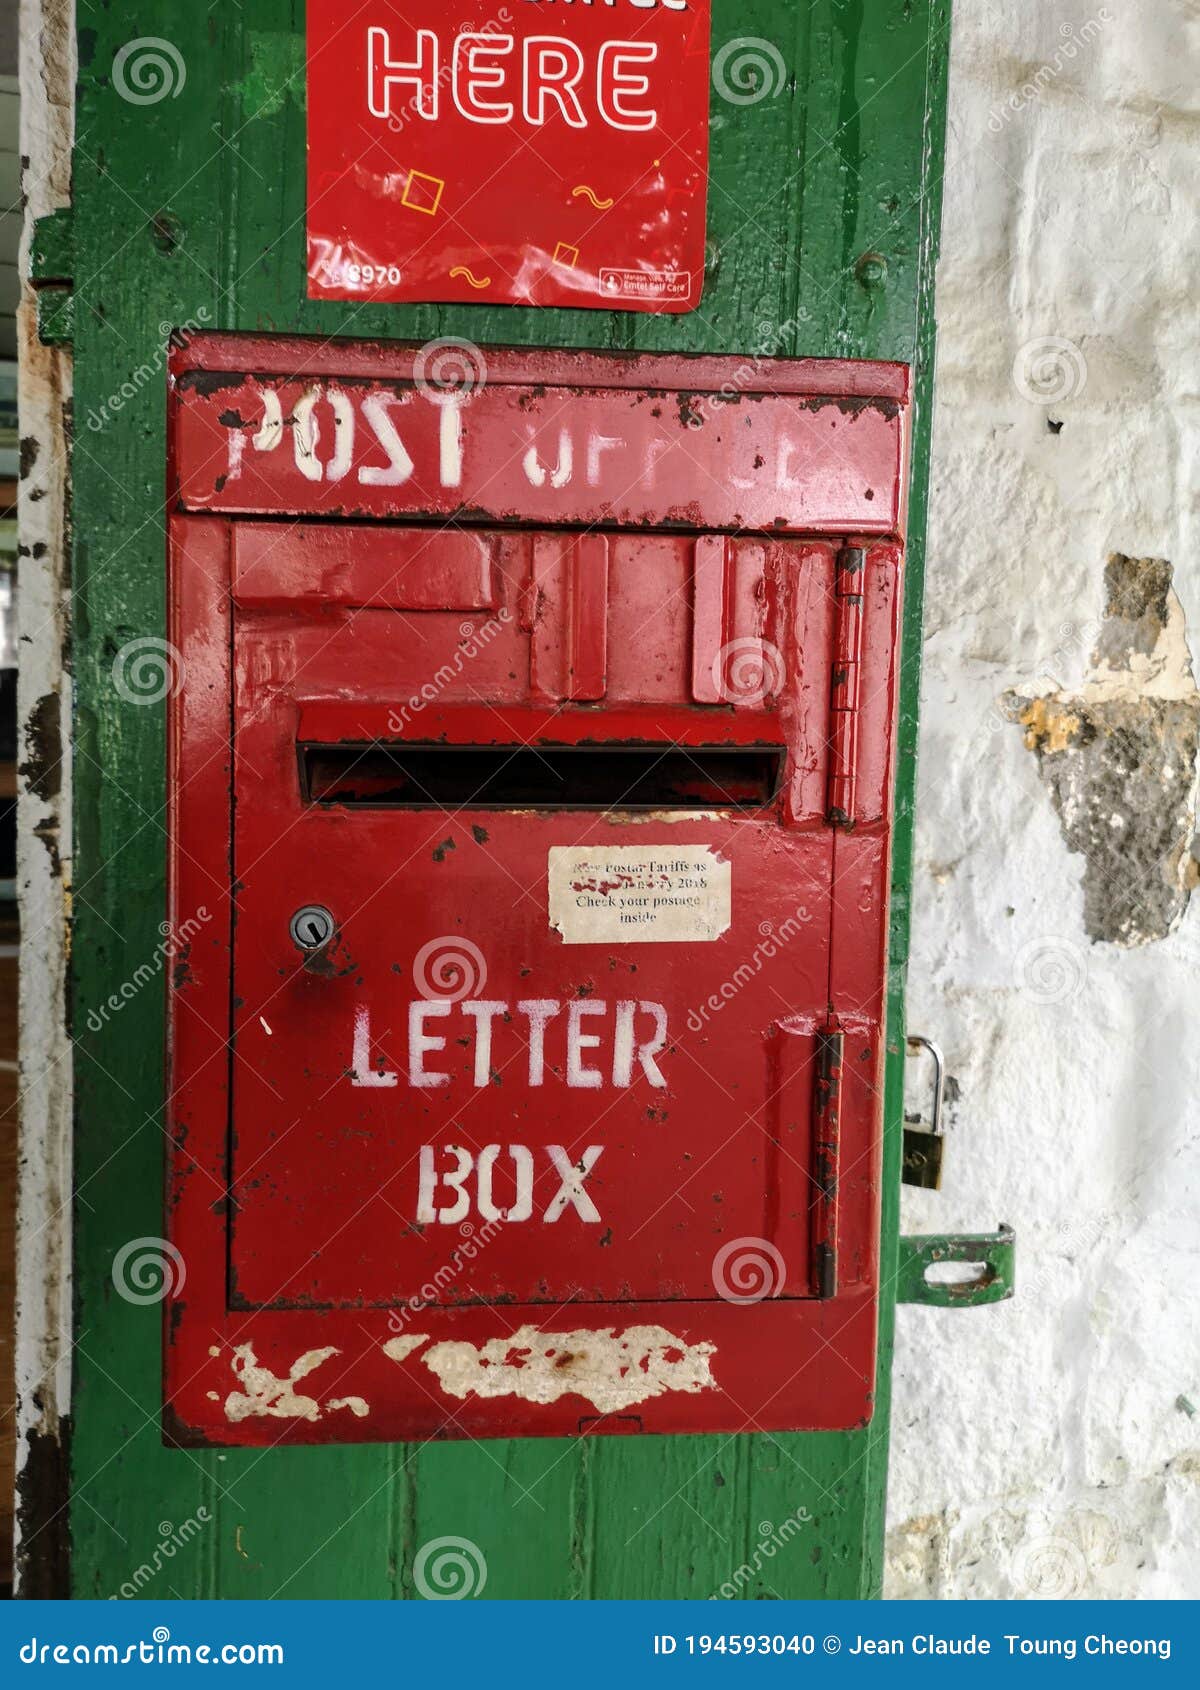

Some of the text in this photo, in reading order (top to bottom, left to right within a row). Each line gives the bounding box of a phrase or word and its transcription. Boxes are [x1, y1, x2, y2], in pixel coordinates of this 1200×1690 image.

[366, 26, 658, 133] HERE
[348, 264, 401, 286] 8970
[623, 280, 648, 291] Emtel
[666, 283, 686, 294] Care
[226, 386, 470, 488] POST
[649, 861, 689, 873] Tariffs
[678, 877, 707, 889] 2018
[576, 895, 615, 907] Check
[619, 897, 650, 909] your
[620, 911, 657, 923] inside
[351, 999, 668, 1088] LETTER
[416, 1144, 604, 1225] BOX
